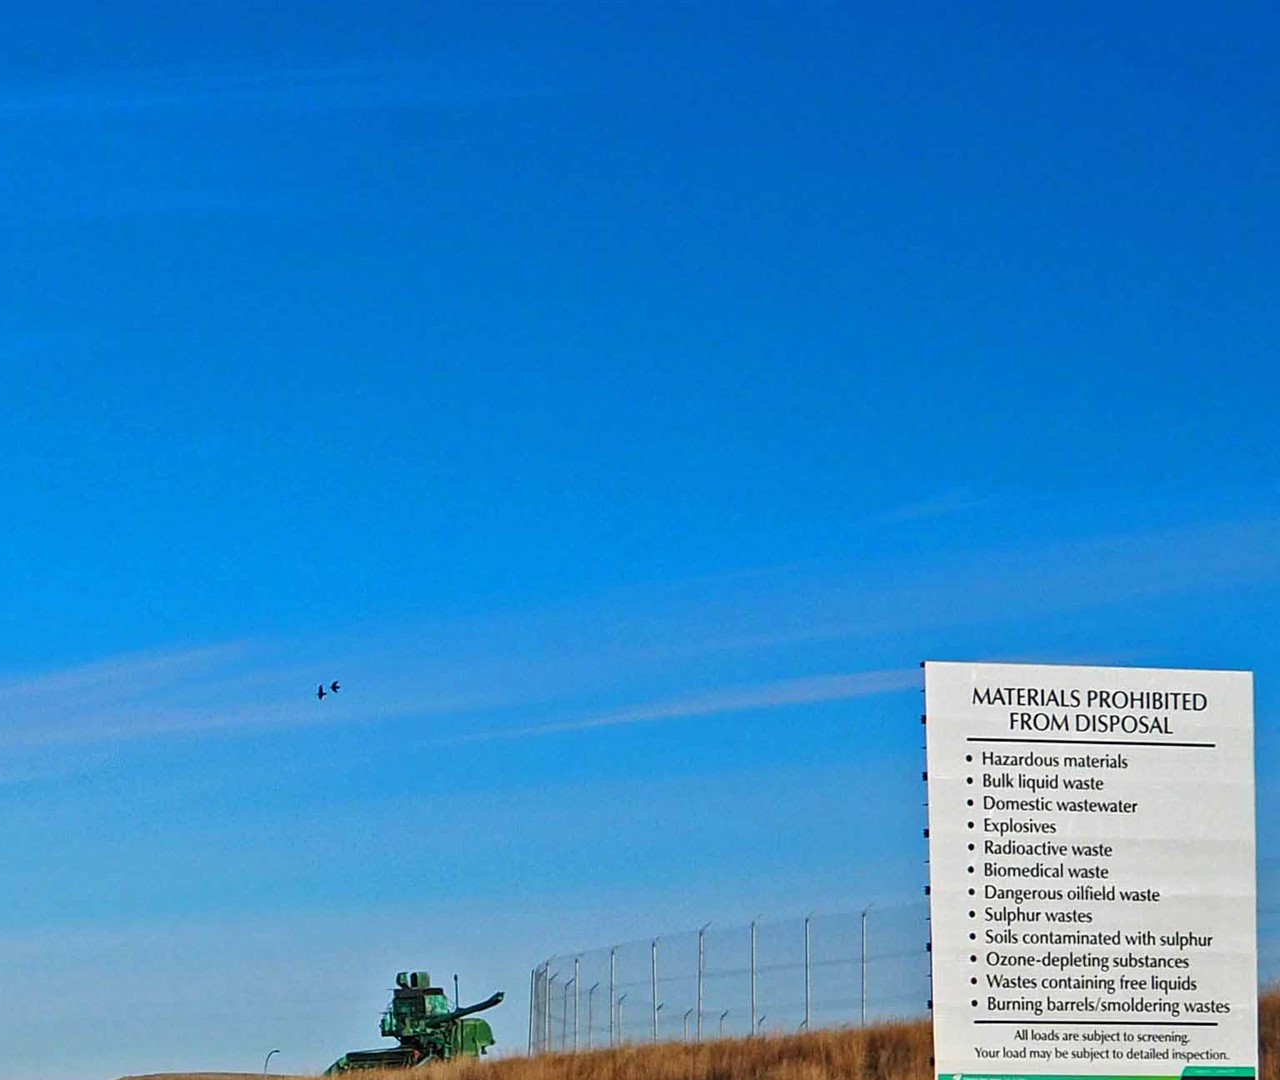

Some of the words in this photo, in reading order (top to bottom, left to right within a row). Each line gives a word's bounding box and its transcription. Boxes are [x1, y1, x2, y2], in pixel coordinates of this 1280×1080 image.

[973, 687, 1081, 708] MATERIALS
[1088, 690, 1207, 711] PROHIBITED
[1010, 712, 1069, 732] FROM
[1076, 714, 1173, 734] DISPOSAL
[982, 751, 1059, 767] Hazardous
[1064, 753, 1128, 769] materials
[983, 773, 1014, 788] Bulk
[1019, 774, 1058, 794] liquid
[1063, 777, 1104, 791] waste
[984, 796, 1052, 812] Domestic
[1056, 799, 1138, 813] wastewater
[984, 818, 1057, 838] Explosives
[985, 841, 1068, 856] Radioactive
[1072, 843, 1113, 857] waste
[984, 862, 1063, 878] Biomedical
[1068, 866, 1109, 879] waste
[985, 885, 1063, 905] Dangerous
[1067, 886, 1115, 901] oilfield
[1119, 889, 1160, 902] waste
[985, 908, 1042, 927] Sulphur
[1045, 909, 1093, 923] wastes
[986, 930, 1018, 944] Soils
[1023, 930, 1121, 946] contaminated
[1125, 932, 1156, 946] with
[1160, 932, 1213, 951] sulphur
[986, 952, 1109, 972] Ozone-depleting
[1113, 954, 1189, 969] substances
[986, 974, 1037, 989] Wastes
[1042, 974, 1116, 995] containing
[1120, 976, 1147, 990] free
[1151, 976, 1197, 995] liquids
[988, 996, 1043, 1016] Burning
[1047, 996, 1180, 1017] barrels/smoldering
[1184, 1000, 1230, 1013] wastes
[1015, 1029, 1028, 1040] All
[1031, 1029, 1060, 1041] loads
[1062, 1033, 1079, 1041] are
[1082, 1030, 1120, 1045] subject
[1124, 1032, 1135, 1042] to
[1137, 1031, 1190, 1046] screening.
[975, 1047, 1000, 1059] Your
[1003, 1047, 1027, 1059] load
[1030, 1050, 1052, 1062] may
[1055, 1047, 1069, 1059] be
[1071, 1047, 1110, 1062] subject
[1113, 1050, 1124, 1059] to
[1126, 1048, 1169, 1060] detailed
[1172, 1048, 1230, 1064] inspection.
